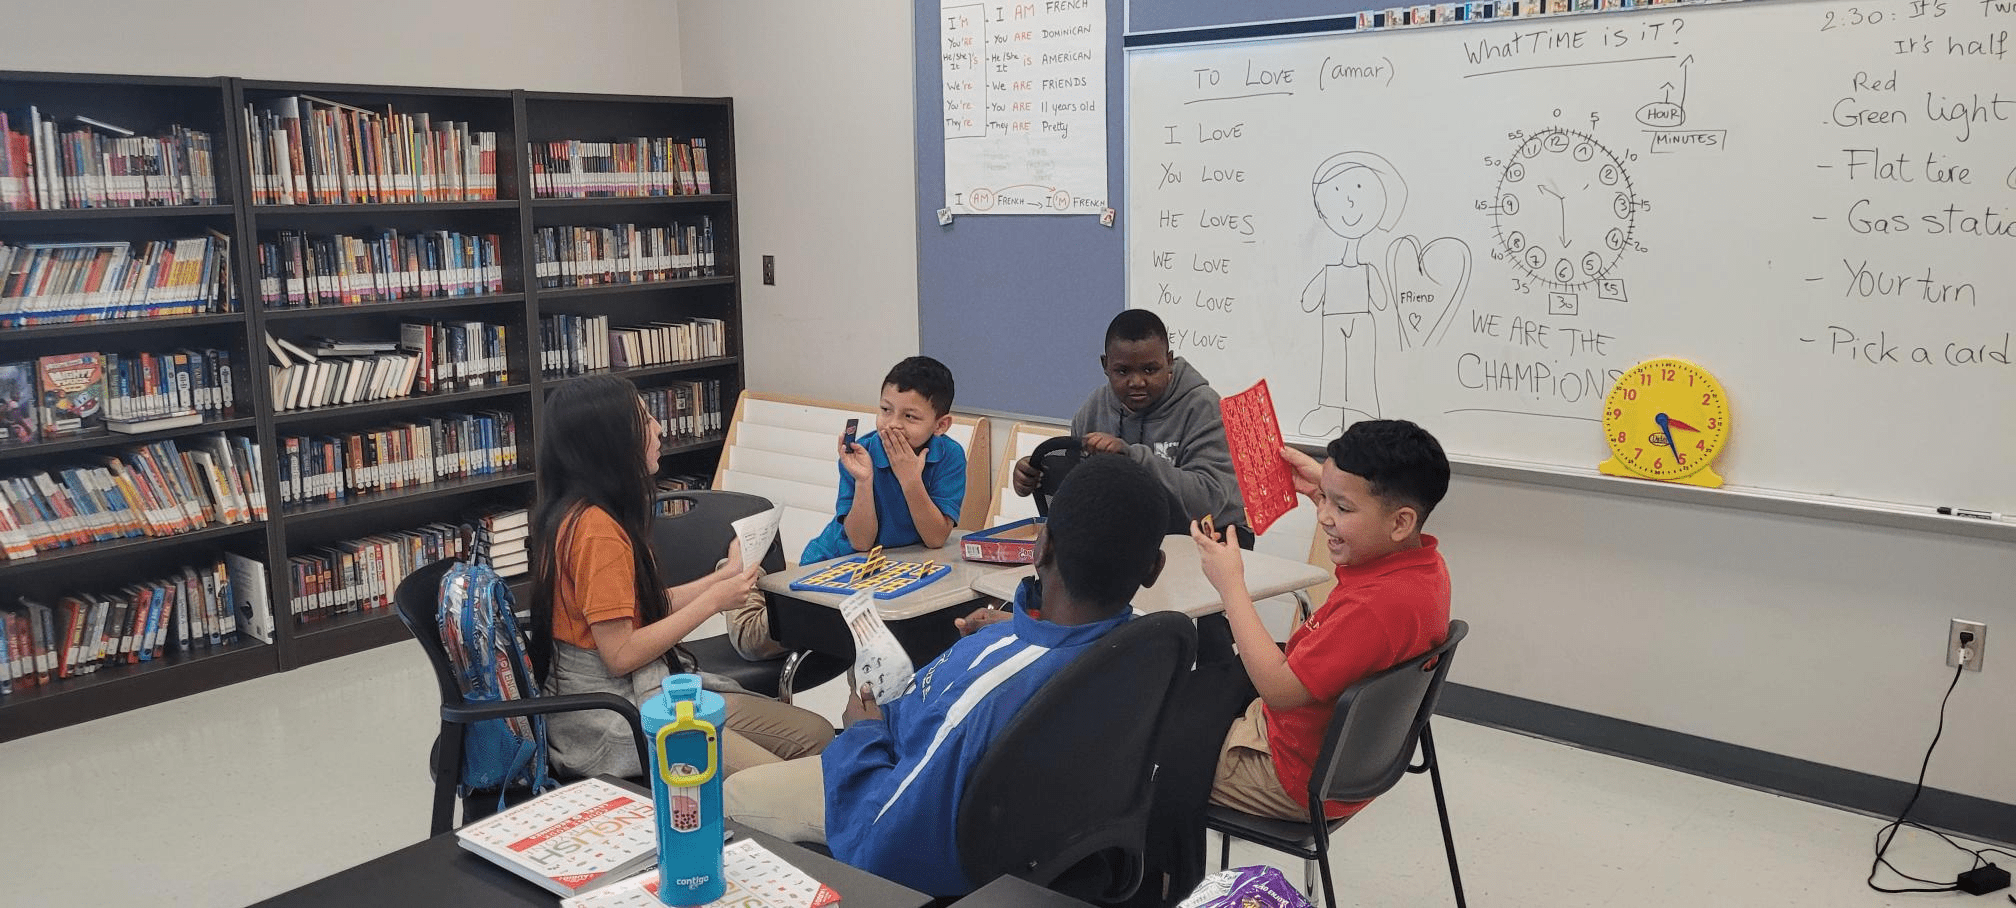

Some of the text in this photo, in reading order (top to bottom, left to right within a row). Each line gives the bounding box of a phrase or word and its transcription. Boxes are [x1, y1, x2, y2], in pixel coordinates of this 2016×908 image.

[996, 0, 1088, 22] I AM FRENCH
[1908, 0, 1947, 18] It's
[1014, 32, 1033, 42] ARE
[1042, 24, 1091, 39] DOMINICAN
[1464, 32, 1522, 65] What
[1948, 31, 2008, 60] half
[1042, 51, 1091, 65] AMERICAN
[996, 64, 1008, 73] It
[1194, 69, 1220, 88] TO
[1245, 59, 1294, 86] LOVE
[947, 80, 974, 91] We're
[992, 77, 1087, 91] We ARE FRIENDS
[1853, 69, 1897, 92] Red
[946, 100, 973, 111] You're
[1012, 101, 1032, 111] ARE
[1041, 102, 1048, 113] 11
[1052, 102, 1077, 113] years
[1080, 101, 1095, 111] old
[1590, 112, 1600, 123] 5
[1646, 109, 1680, 121] HOUR
[1832, 92, 2016, 142] Green light
[946, 118, 973, 130] They're
[989, 121, 1068, 139] They ARE Pretty
[1164, 123, 1244, 145] I LOVE
[1508, 130, 1524, 140] 55
[1656, 133, 1717, 147] MINUTES
[1625, 148, 1638, 161] 10
[1484, 156, 1501, 167] 50
[1842, 147, 1914, 184] Flat
[1202, 166, 1245, 182] LOVE
[1509, 169, 1521, 178] 10
[1604, 168, 1614, 179] 2
[955, 193, 963, 205] I
[973, 194, 989, 204] AM
[997, 195, 1025, 205] FRENCH
[1073, 197, 1105, 207] FRENCH
[1474, 200, 1488, 211] 45
[1507, 200, 1514, 212] 9
[1620, 199, 1628, 212] 3
[1159, 209, 1256, 236] HE LOVES
[1848, 199, 1910, 234] Gas
[1513, 238, 1520, 249] 8
[1611, 233, 1619, 245] 4
[1634, 241, 1648, 253] 20
[1490, 248, 1504, 260] 40
[1530, 255, 1539, 266] 7
[1153, 250, 1231, 275] WE LOVE
[1585, 259, 1594, 271] 5
[1558, 266, 1568, 278] 6
[1511, 278, 1530, 294] 35
[1916, 267, 1976, 307] turn
[1195, 290, 1235, 313] LOVE
[1557, 296, 1573, 309] 30
[1472, 309, 1616, 357] WE ARE THE
[1193, 330, 1228, 350] LOVE
[1828, 325, 2012, 367] Pick a card
[1640, 373, 1652, 386] 11
[1662, 369, 1675, 382] 12
[1689, 375, 1694, 387] 1
[1623, 388, 1637, 401] 10
[1702, 393, 1711, 406] 2
[1613, 408, 1622, 420] 9
[1707, 418, 1717, 430] 3
[1618, 432, 1626, 443] 8
[1696, 440, 1706, 451] 4
[1634, 448, 1643, 460] 7
[1679, 453, 1687, 465] 5
[1654, 458, 1663, 469] 6
[676, 875, 709, 886] contigo
